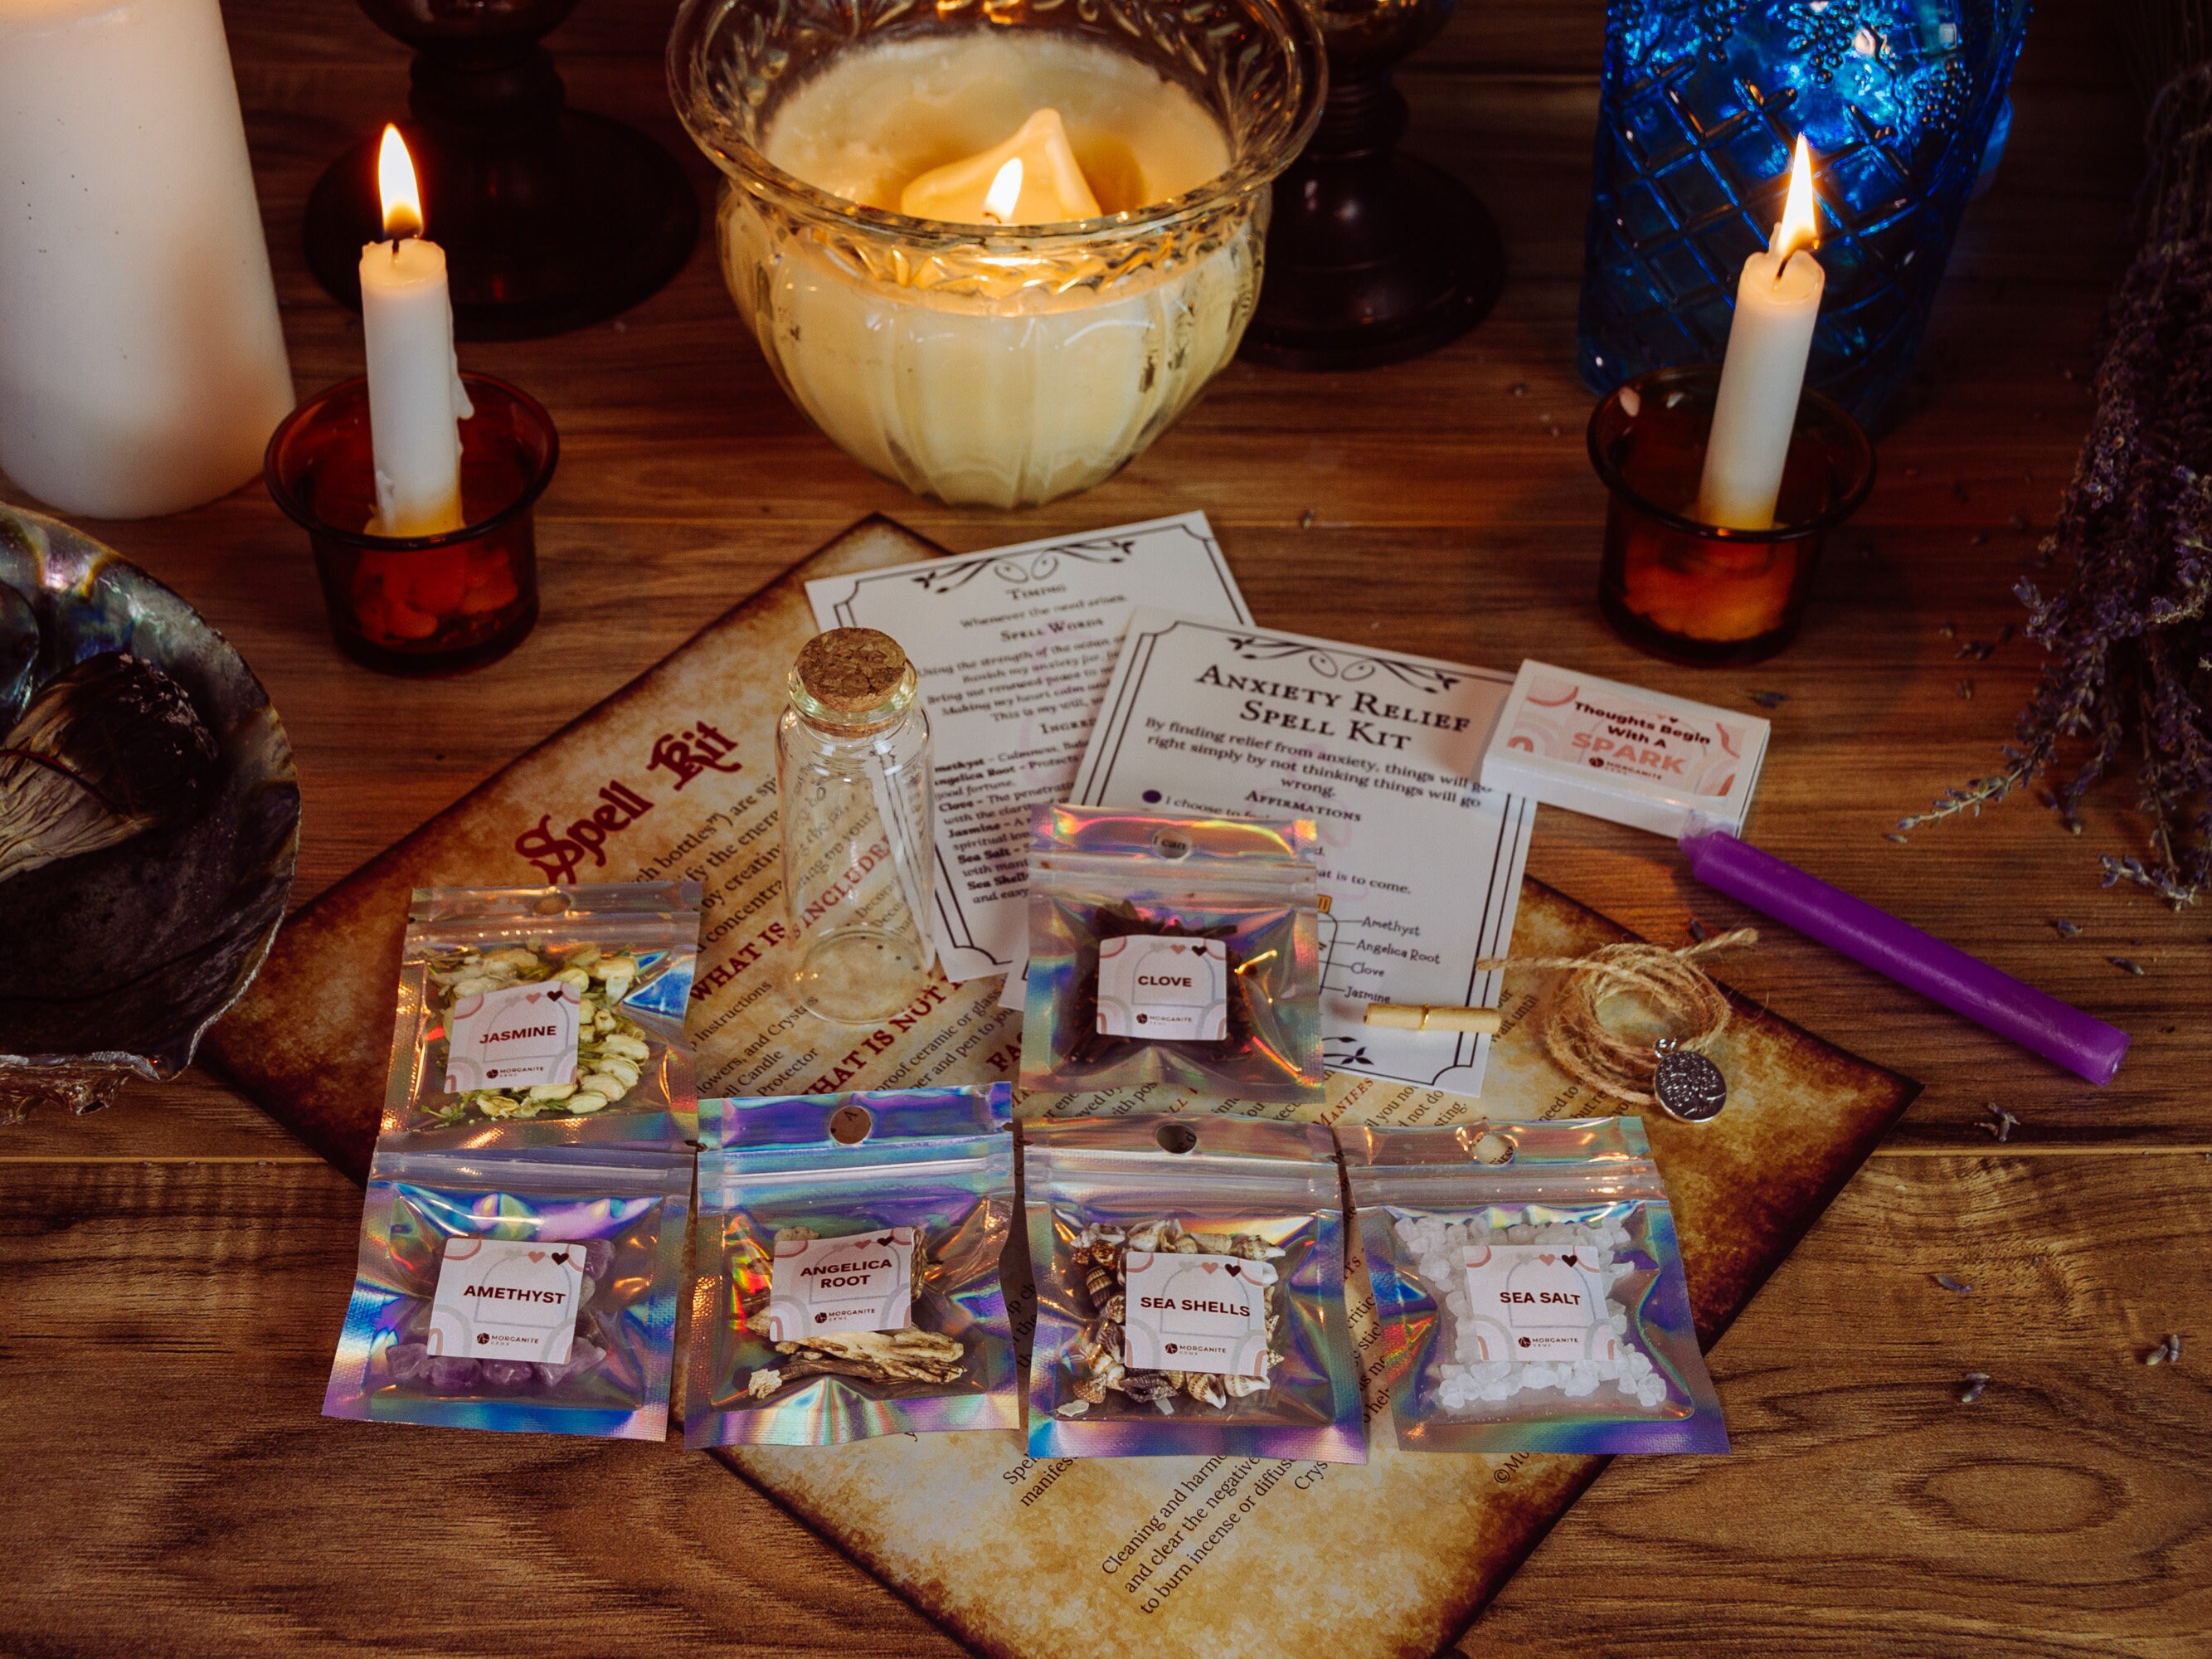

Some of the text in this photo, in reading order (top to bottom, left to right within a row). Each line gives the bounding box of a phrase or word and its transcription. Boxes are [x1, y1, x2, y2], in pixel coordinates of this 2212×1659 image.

[960, 611, 1025, 628] Whenever
[956, 659, 977, 670] the
[1574, 701, 1712, 746] Thoughts Begin
[1607, 725, 1667, 749] With A
[645, 719, 743, 791] Kit
[1145, 717, 1165, 736] By
[1168, 718, 1226, 745] finding
[1229, 732, 1271, 752] relief
[1275, 738, 1314, 760] from
[1316, 748, 1381, 773] anxiety,
[1384, 762, 1436, 786] things
[1439, 775, 1470, 789] will
[1572, 732, 1686, 774] SPARK
[935, 757, 986, 773] methyst
[1146, 732, 1481, 809] right simply by not thinking things will go
[1280, 776, 1337, 799] wrong.
[729, 795, 757, 817] are
[938, 792, 1011, 814] Clove The
[975, 808, 997, 820] the
[947, 822, 1002, 840] Jasmine
[706, 843, 739, 870] the
[957, 853, 983, 865] Sea
[984, 846, 1012, 860] Salt
[967, 878, 993, 892] Sea
[1317, 870, 1332, 878] at
[1351, 874, 1366, 885] to
[1369, 878, 1412, 895] come.
[972, 891, 999, 905] and
[1361, 916, 1421, 937] Amethyst
[689, 942, 764, 1002] WHAT
[756, 921, 788, 948] IS
[1355, 939, 1441, 966] Angelica Root
[1349, 961, 1385, 977] Clove
[1137, 975, 1193, 989] CLOVE
[1344, 985, 1392, 1004] Jasmine
[696, 979, 773, 1043] Instructions
[1514, 993, 1538, 1021] until
[479, 1025, 557, 1045] JASMINE
[860, 1029, 897, 1057] IS
[908, 1022, 960, 1067] ceramic
[956, 1013, 973, 1029] or
[933, 1020, 995, 1076] and pen to
[696, 1033, 771, 1097] lowers, and
[735, 1048, 785, 1092] Candle
[756, 1046, 819, 1097] Protector
[1567, 1085, 1579, 1100] to
[1375, 1099, 1400, 1124] you
[1407, 1102, 1431, 1124] not
[1427, 1089, 1445, 1105] do
[800, 1258, 892, 1277] ANGELICA
[820, 1274, 872, 1289] ROOT
[463, 1285, 566, 1305] AMETHYST
[1500, 1292, 1582, 1306] SEA SALT
[829, 1307, 876, 1318] MORGANITE
[1140, 1296, 1252, 1317] SEA SHELLS
[491, 1334, 539, 1345] MORGANITE
[1179, 1344, 1228, 1354] MORGANITE
[1101, 1487, 1189, 1575] Cleaning and
[1124, 1456, 1262, 1594] and clear the negative
[1140, 1494, 1257, 1616] to burn incense or
